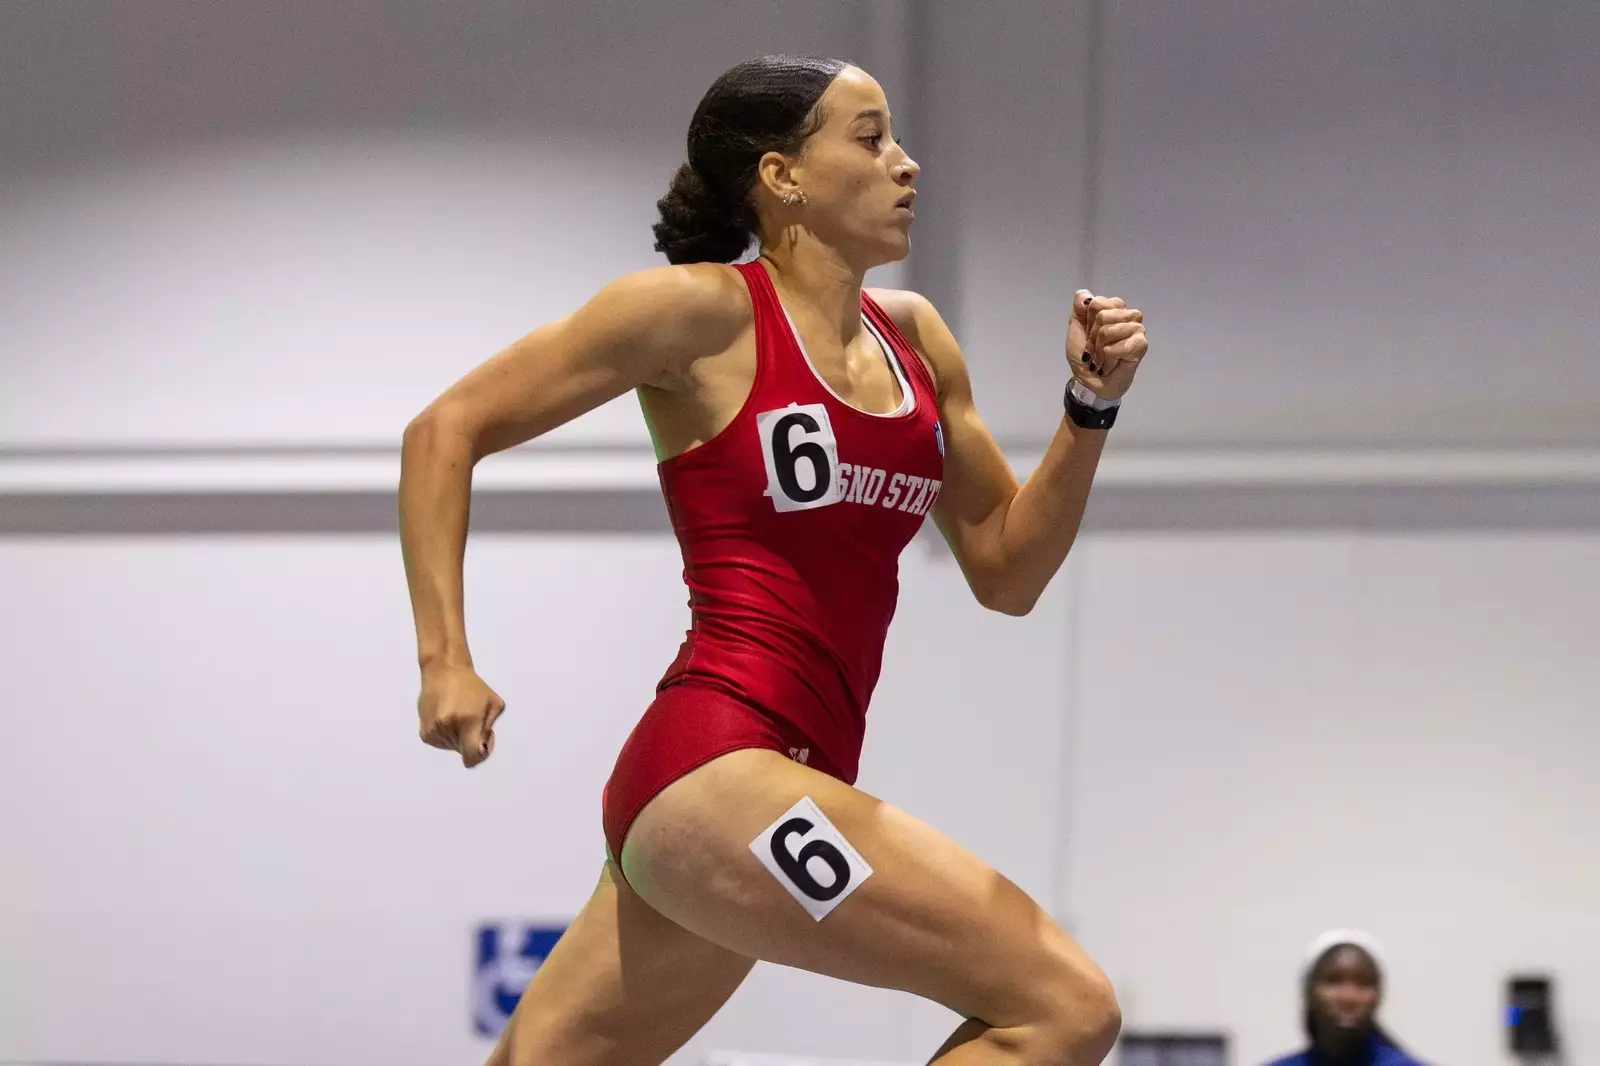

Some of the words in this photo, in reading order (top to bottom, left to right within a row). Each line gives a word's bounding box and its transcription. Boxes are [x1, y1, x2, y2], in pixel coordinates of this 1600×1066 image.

[772, 413, 830, 503] 6
[882, 473, 942, 516] STAT
[770, 817, 851, 902] 6
